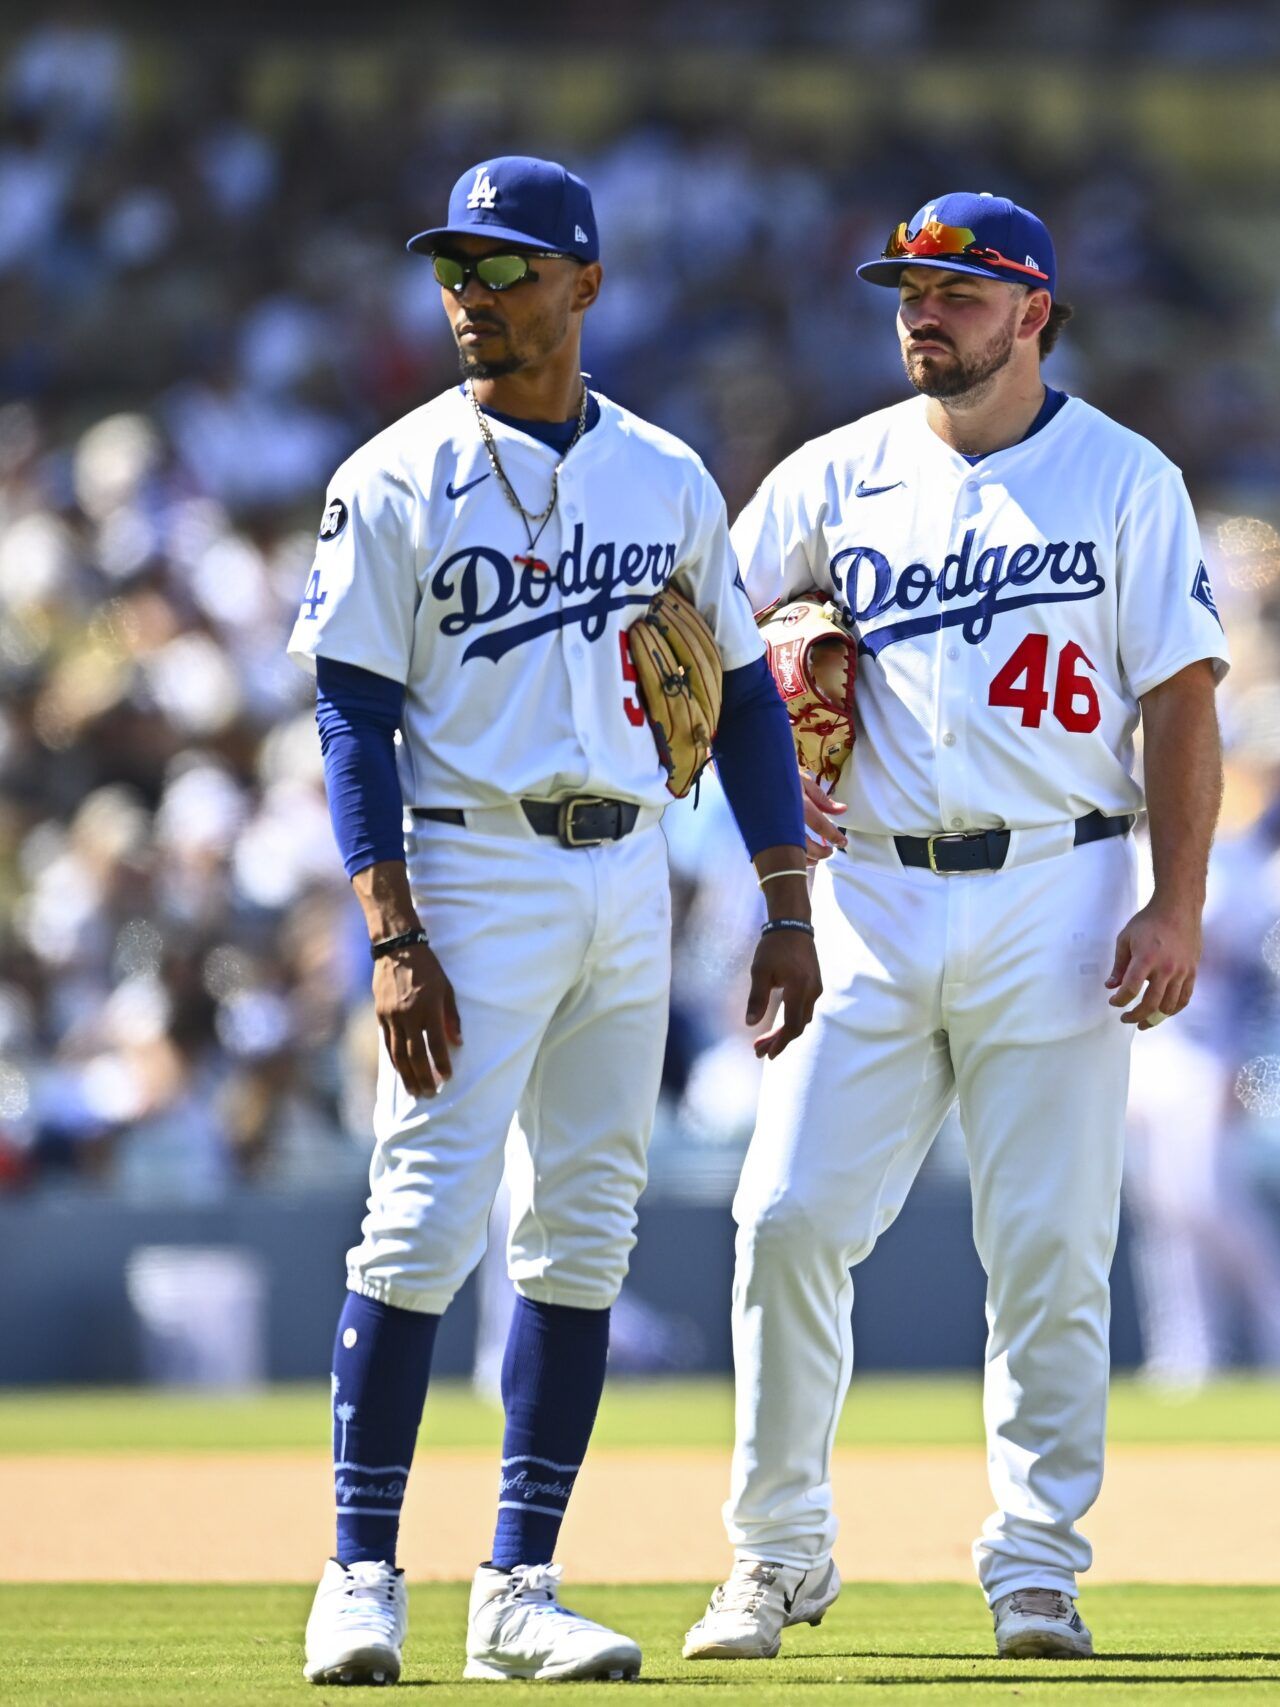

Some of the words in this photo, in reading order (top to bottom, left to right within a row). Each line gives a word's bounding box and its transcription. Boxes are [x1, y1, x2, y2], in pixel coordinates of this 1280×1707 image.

[466, 167, 498, 209] LA
[829, 529, 1106, 657] Dodgers
[988, 633, 1102, 734] 46
